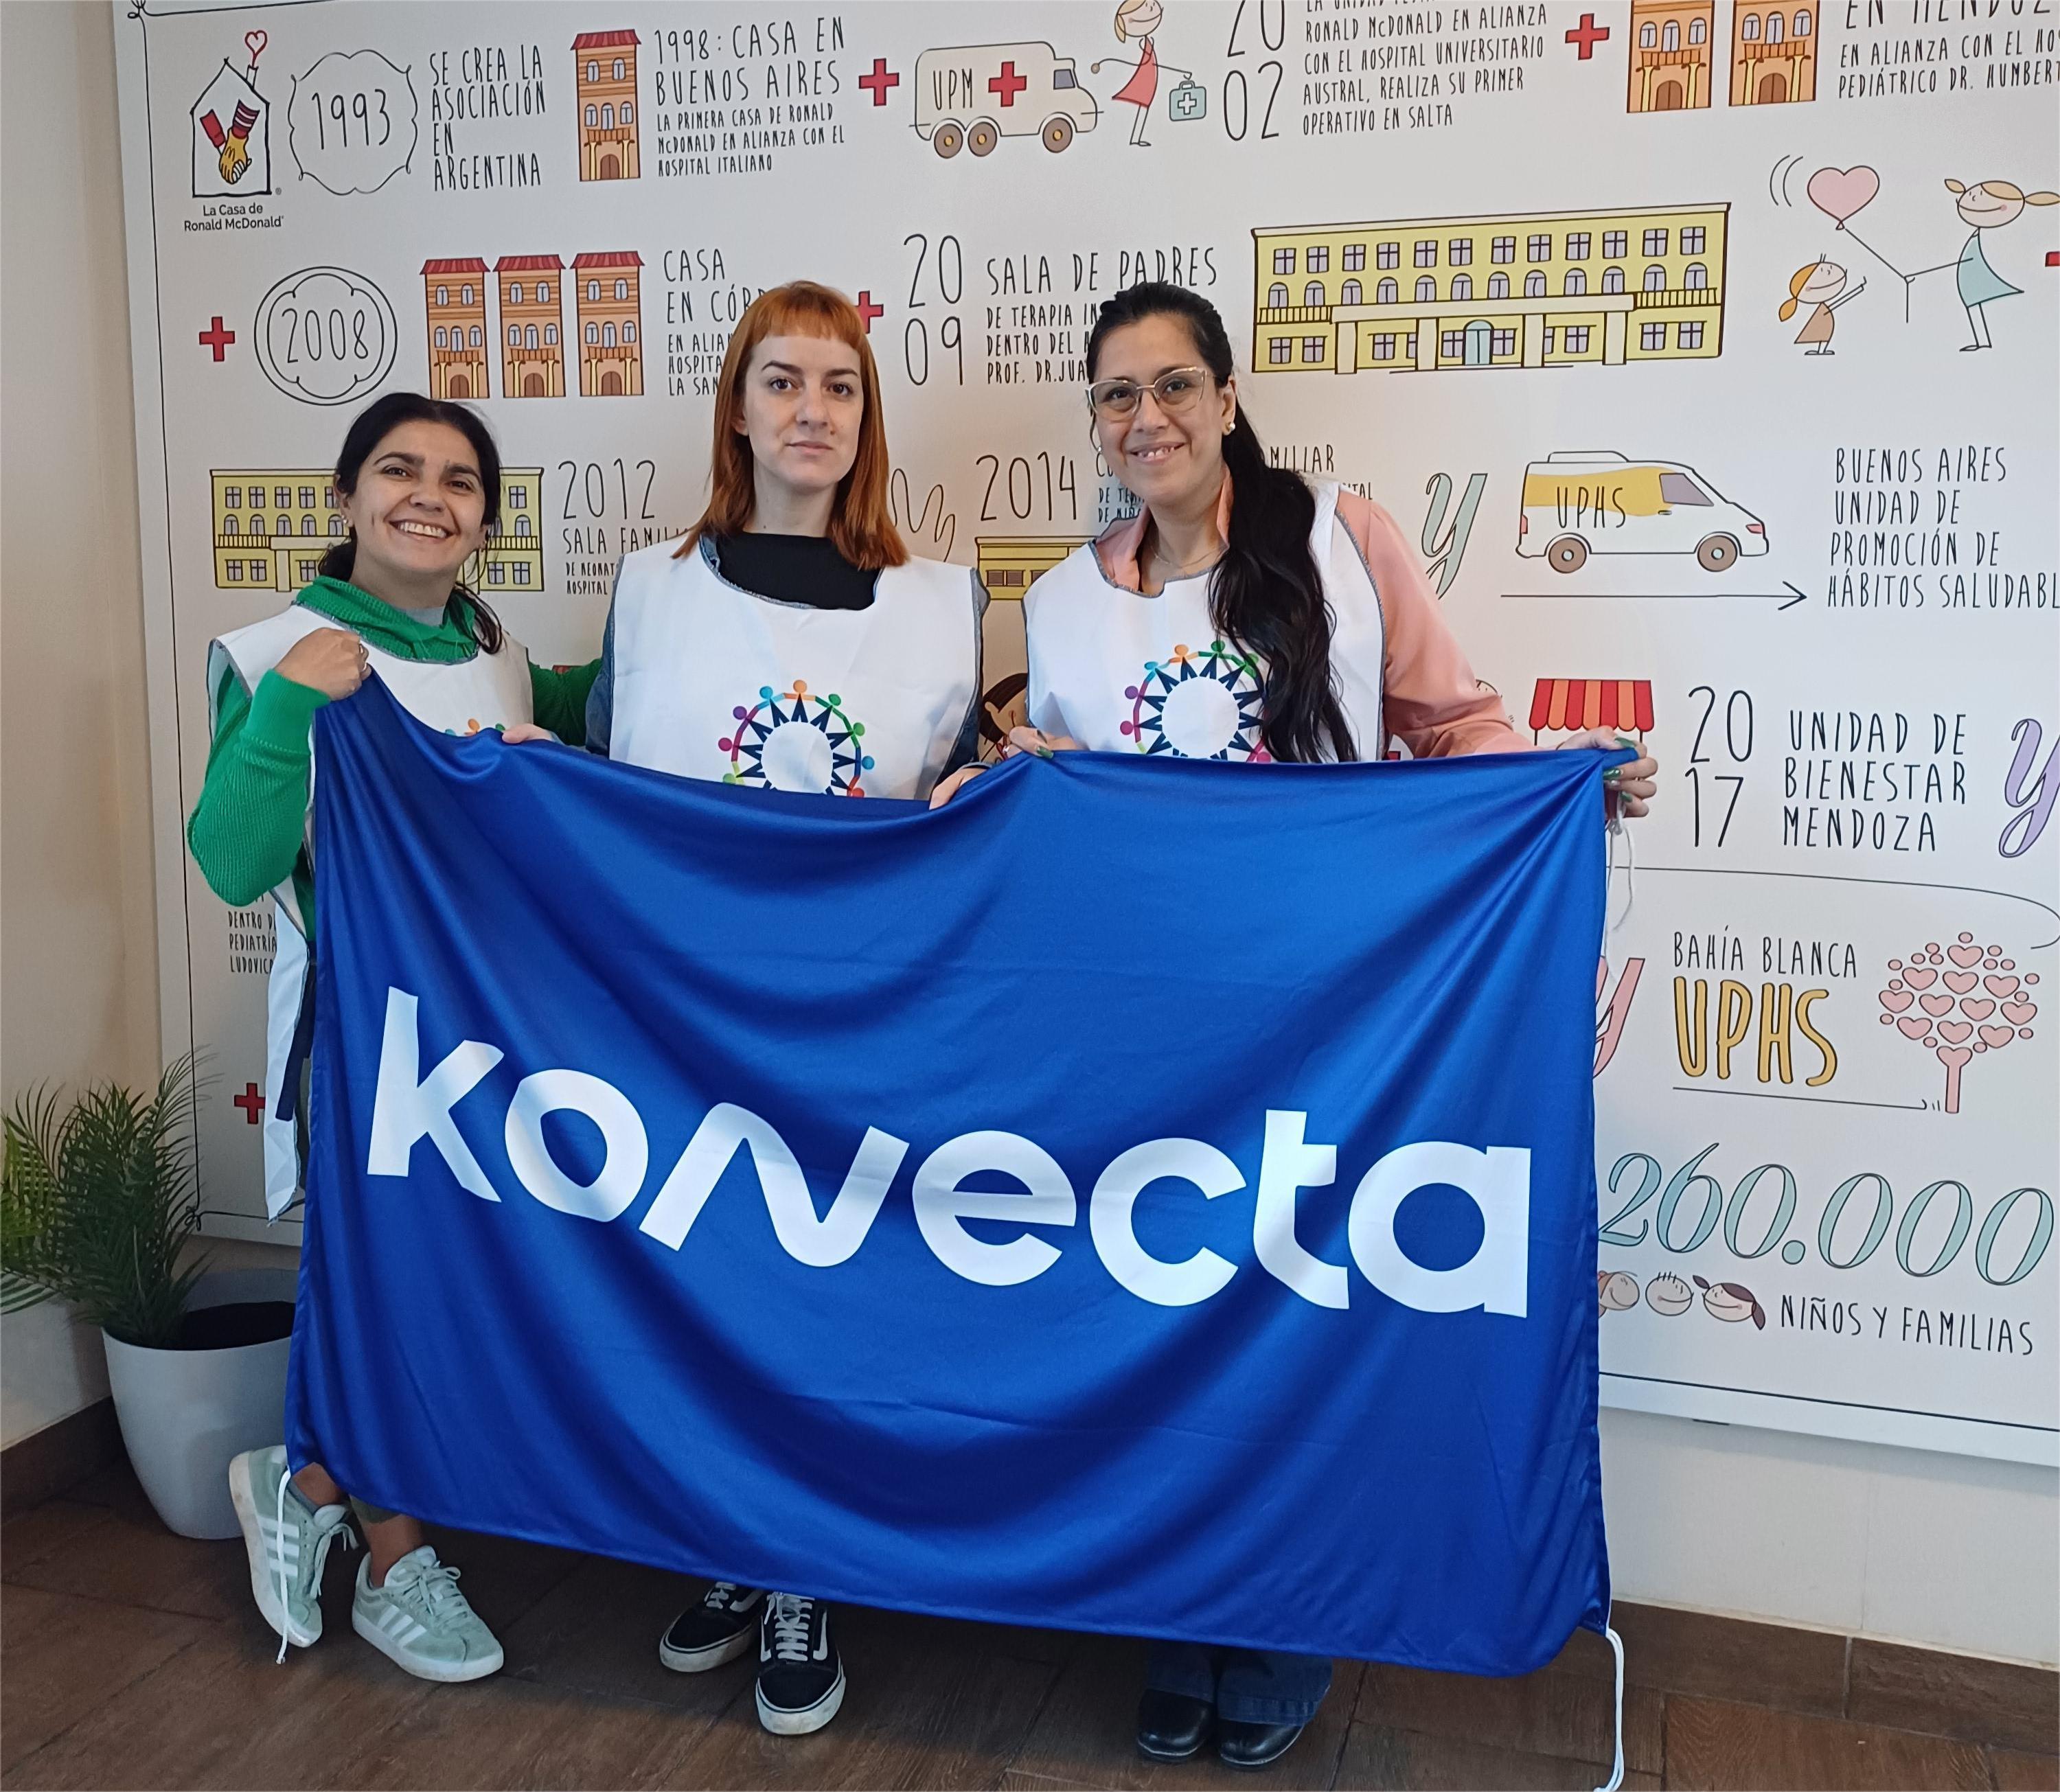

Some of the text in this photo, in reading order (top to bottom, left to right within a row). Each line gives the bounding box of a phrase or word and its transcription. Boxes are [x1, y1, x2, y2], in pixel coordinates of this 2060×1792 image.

[654, 16, 844, 65] 1998: CASA EN
[1306, 3, 1546, 43] RONALD McDONALD EN ALIANZA
[429, 44, 542, 87] SE CREA LA
[1304, 34, 1543, 76] CON EL HOSPITAL UNIVERSITARIO
[1840, 28, 2060, 69] EN ALIANZA CON EL HO
[431, 80, 547, 122] ASOCIACIÓN
[655, 60, 840, 106] BUENOS AIRES
[932, 68, 973, 111] UPM
[1223, 60, 1283, 141] 02
[1303, 66, 1523, 106] AUSTRAL, REALIZA SU PRIMER
[1839, 67, 1936, 99] PEDIÁTRICO
[1949, 65, 1973, 91] DR.
[311, 88, 391, 150] 1993
[656, 102, 833, 133] LA PRIMERA CASA DE RONALD
[1303, 103, 1452, 136] OPERATIVO EN SALTA
[433, 123, 455, 157] EN
[658, 124, 845, 154] McDONALD EN ALIANZA CON EL
[433, 152, 542, 192] ARGENTINA
[658, 154, 772, 177] HOSPITAL ITALIANO
[184, 215, 284, 231] Ronald McDonald
[203, 202, 263, 217] La Casa de
[663, 248, 725, 282] CASA
[903, 233, 962, 309] 20
[987, 246, 1217, 296] SALA DE PADRES
[667, 283, 766, 324] EN CÓR
[986, 306, 1002, 330] DE
[1011, 303, 1073, 328] TERAPIA
[282, 308, 369, 364] 2008
[668, 334, 684, 354] EN
[904, 316, 963, 386] 09
[986, 332, 1039, 357] DENTRO
[1049, 330, 1073, 355] DEL
[668, 376, 685, 396] LA
[987, 361, 1026, 384] PROF.
[1836, 445, 2006, 484] BUENOS AIRES
[558, 457, 656, 520] 2012
[976, 450, 1077, 522] 2014
[1557, 485, 1626, 529] UPHS
[1835, 489, 1960, 525] UNIDAD DE
[562, 526, 607, 555] SALA
[1831, 527, 2000, 566] PROMOCIÓN DE
[566, 562, 575, 577] DE
[566, 579, 608, 595] HOSPITAL
[1827, 567, 2060, 609] HÁBITOS SALUDABL
[1688, 685, 1753, 764] 20
[1789, 709, 1967, 755] UNIDAD DE
[1785, 757, 1965, 805] BIENESTAR
[1684, 767, 1744, 848] 17
[1783, 805, 1936, 852] MENDOZA
[228, 910, 262, 930] DENTRO
[1674, 925, 1857, 978] BAHÍA BLANCA
[1673, 975, 1839, 1087] UPHS
[1597, 1142, 2055, 1286] 260.000
[1781, 1294, 2033, 1356] NIÑOS Y FAMILIAS
